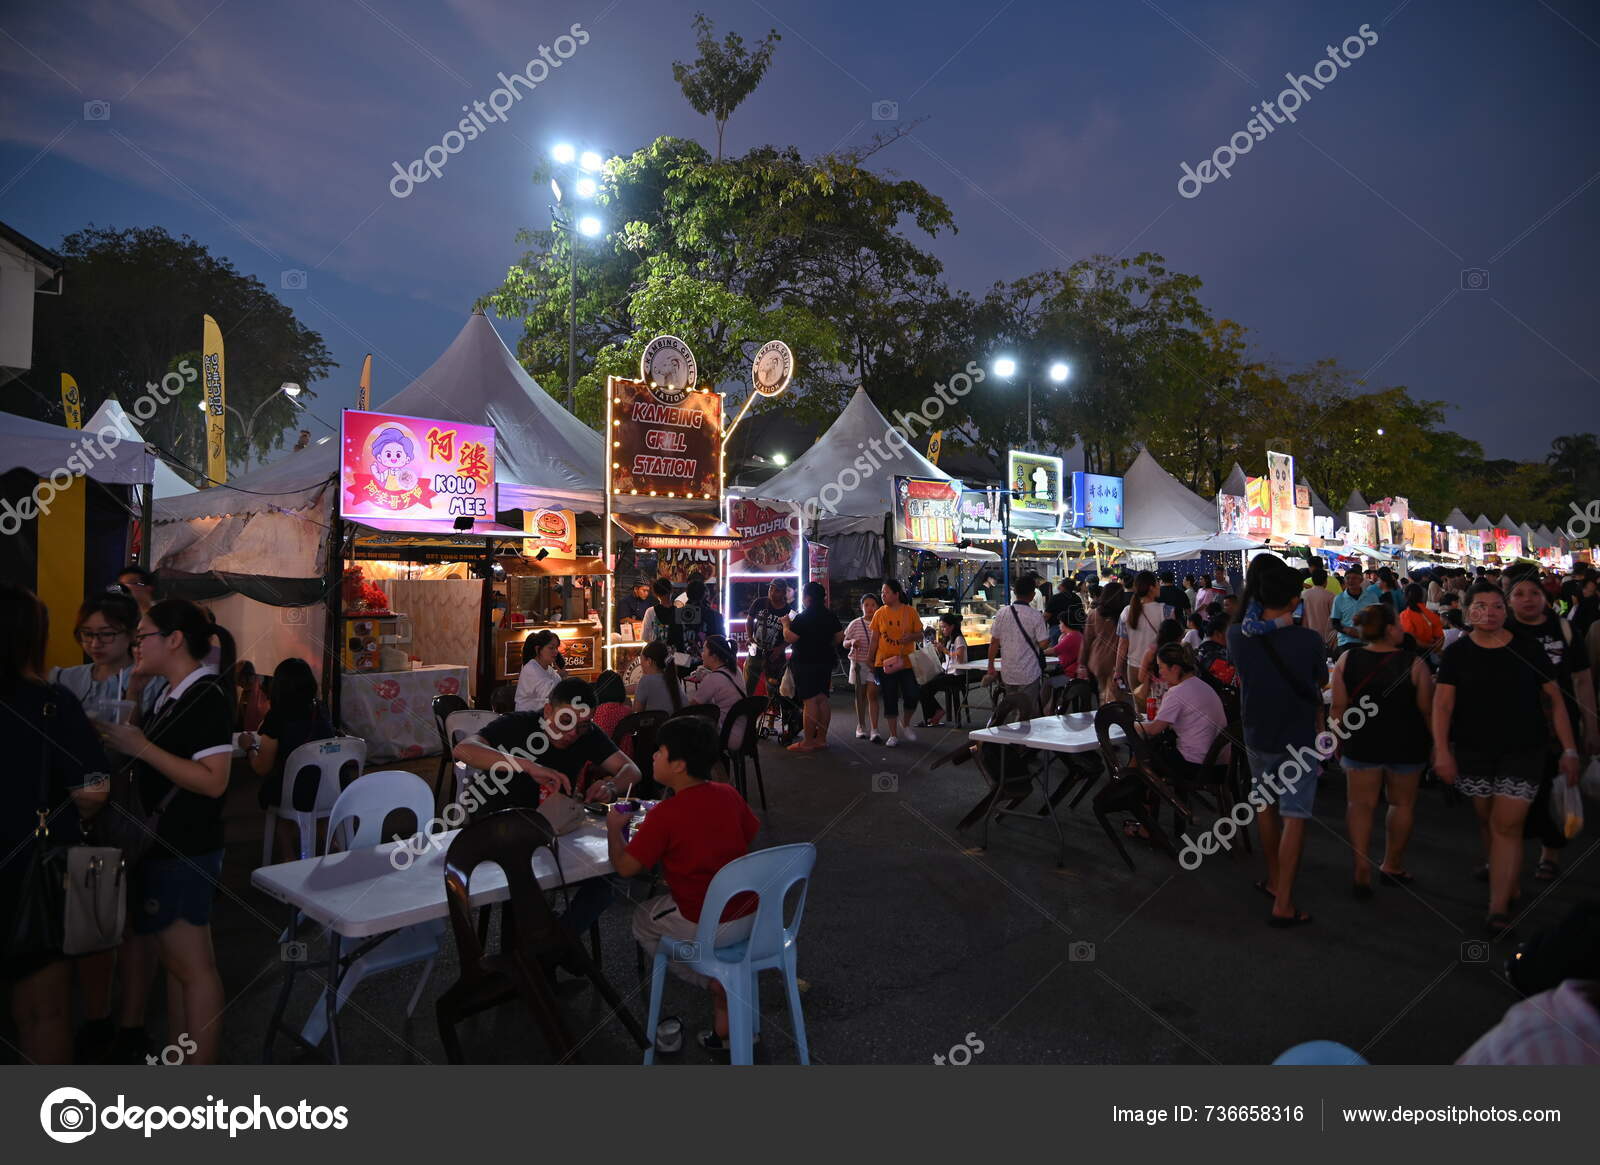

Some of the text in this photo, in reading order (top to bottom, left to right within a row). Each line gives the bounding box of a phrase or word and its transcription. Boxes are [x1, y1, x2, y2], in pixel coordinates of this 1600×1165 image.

[646, 340, 678, 364] KAMBING
[211, 353, 223, 415] KUCHING
[654, 388, 685, 402] TATION
[632, 401, 703, 429] KAMBING
[645, 430, 687, 452] GRILL
[425, 426, 490, 485] 阿婆
[632, 455, 696, 478] STATION
[434, 474, 477, 495] KOLO
[449, 497, 487, 516] MEE
[736, 517, 791, 538] TAKOYAK
